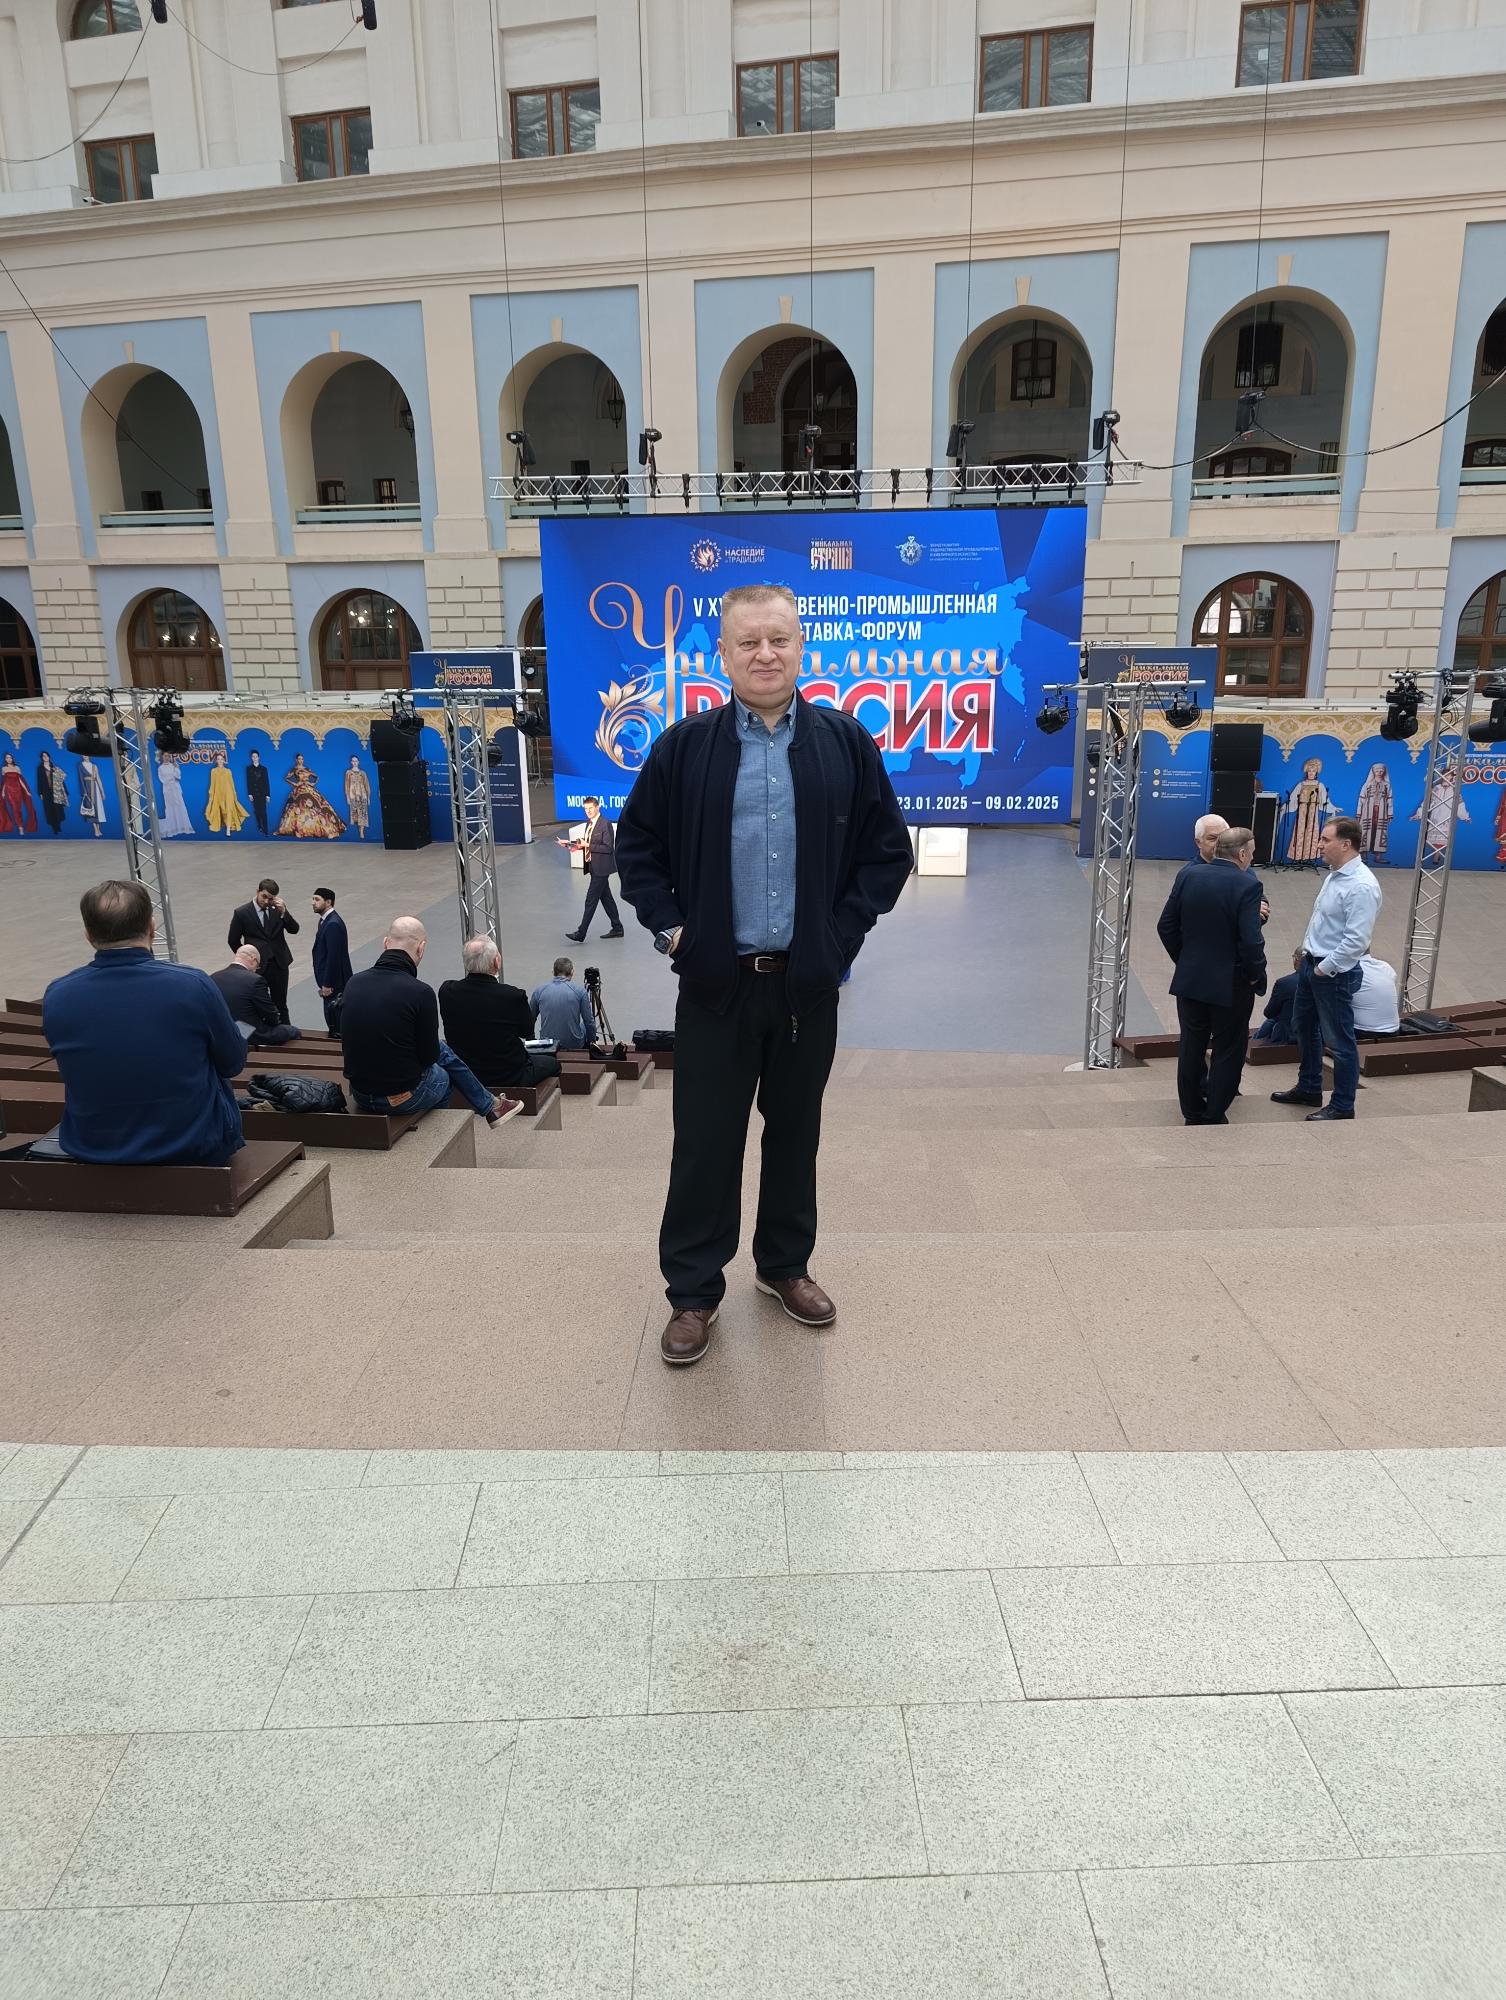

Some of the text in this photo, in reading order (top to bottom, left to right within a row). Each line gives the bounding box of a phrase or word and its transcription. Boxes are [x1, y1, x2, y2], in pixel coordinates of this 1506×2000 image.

[724, 548, 766, 557] НАСЛЕДИЕ
[799, 621, 922, 642] ТАВКА-ФОРУМ
[446, 672, 493, 686] РОССИЯ
[1132, 670, 1189, 682] РОССИЯ
[985, 795, 1059, 810] 09.02.2025
